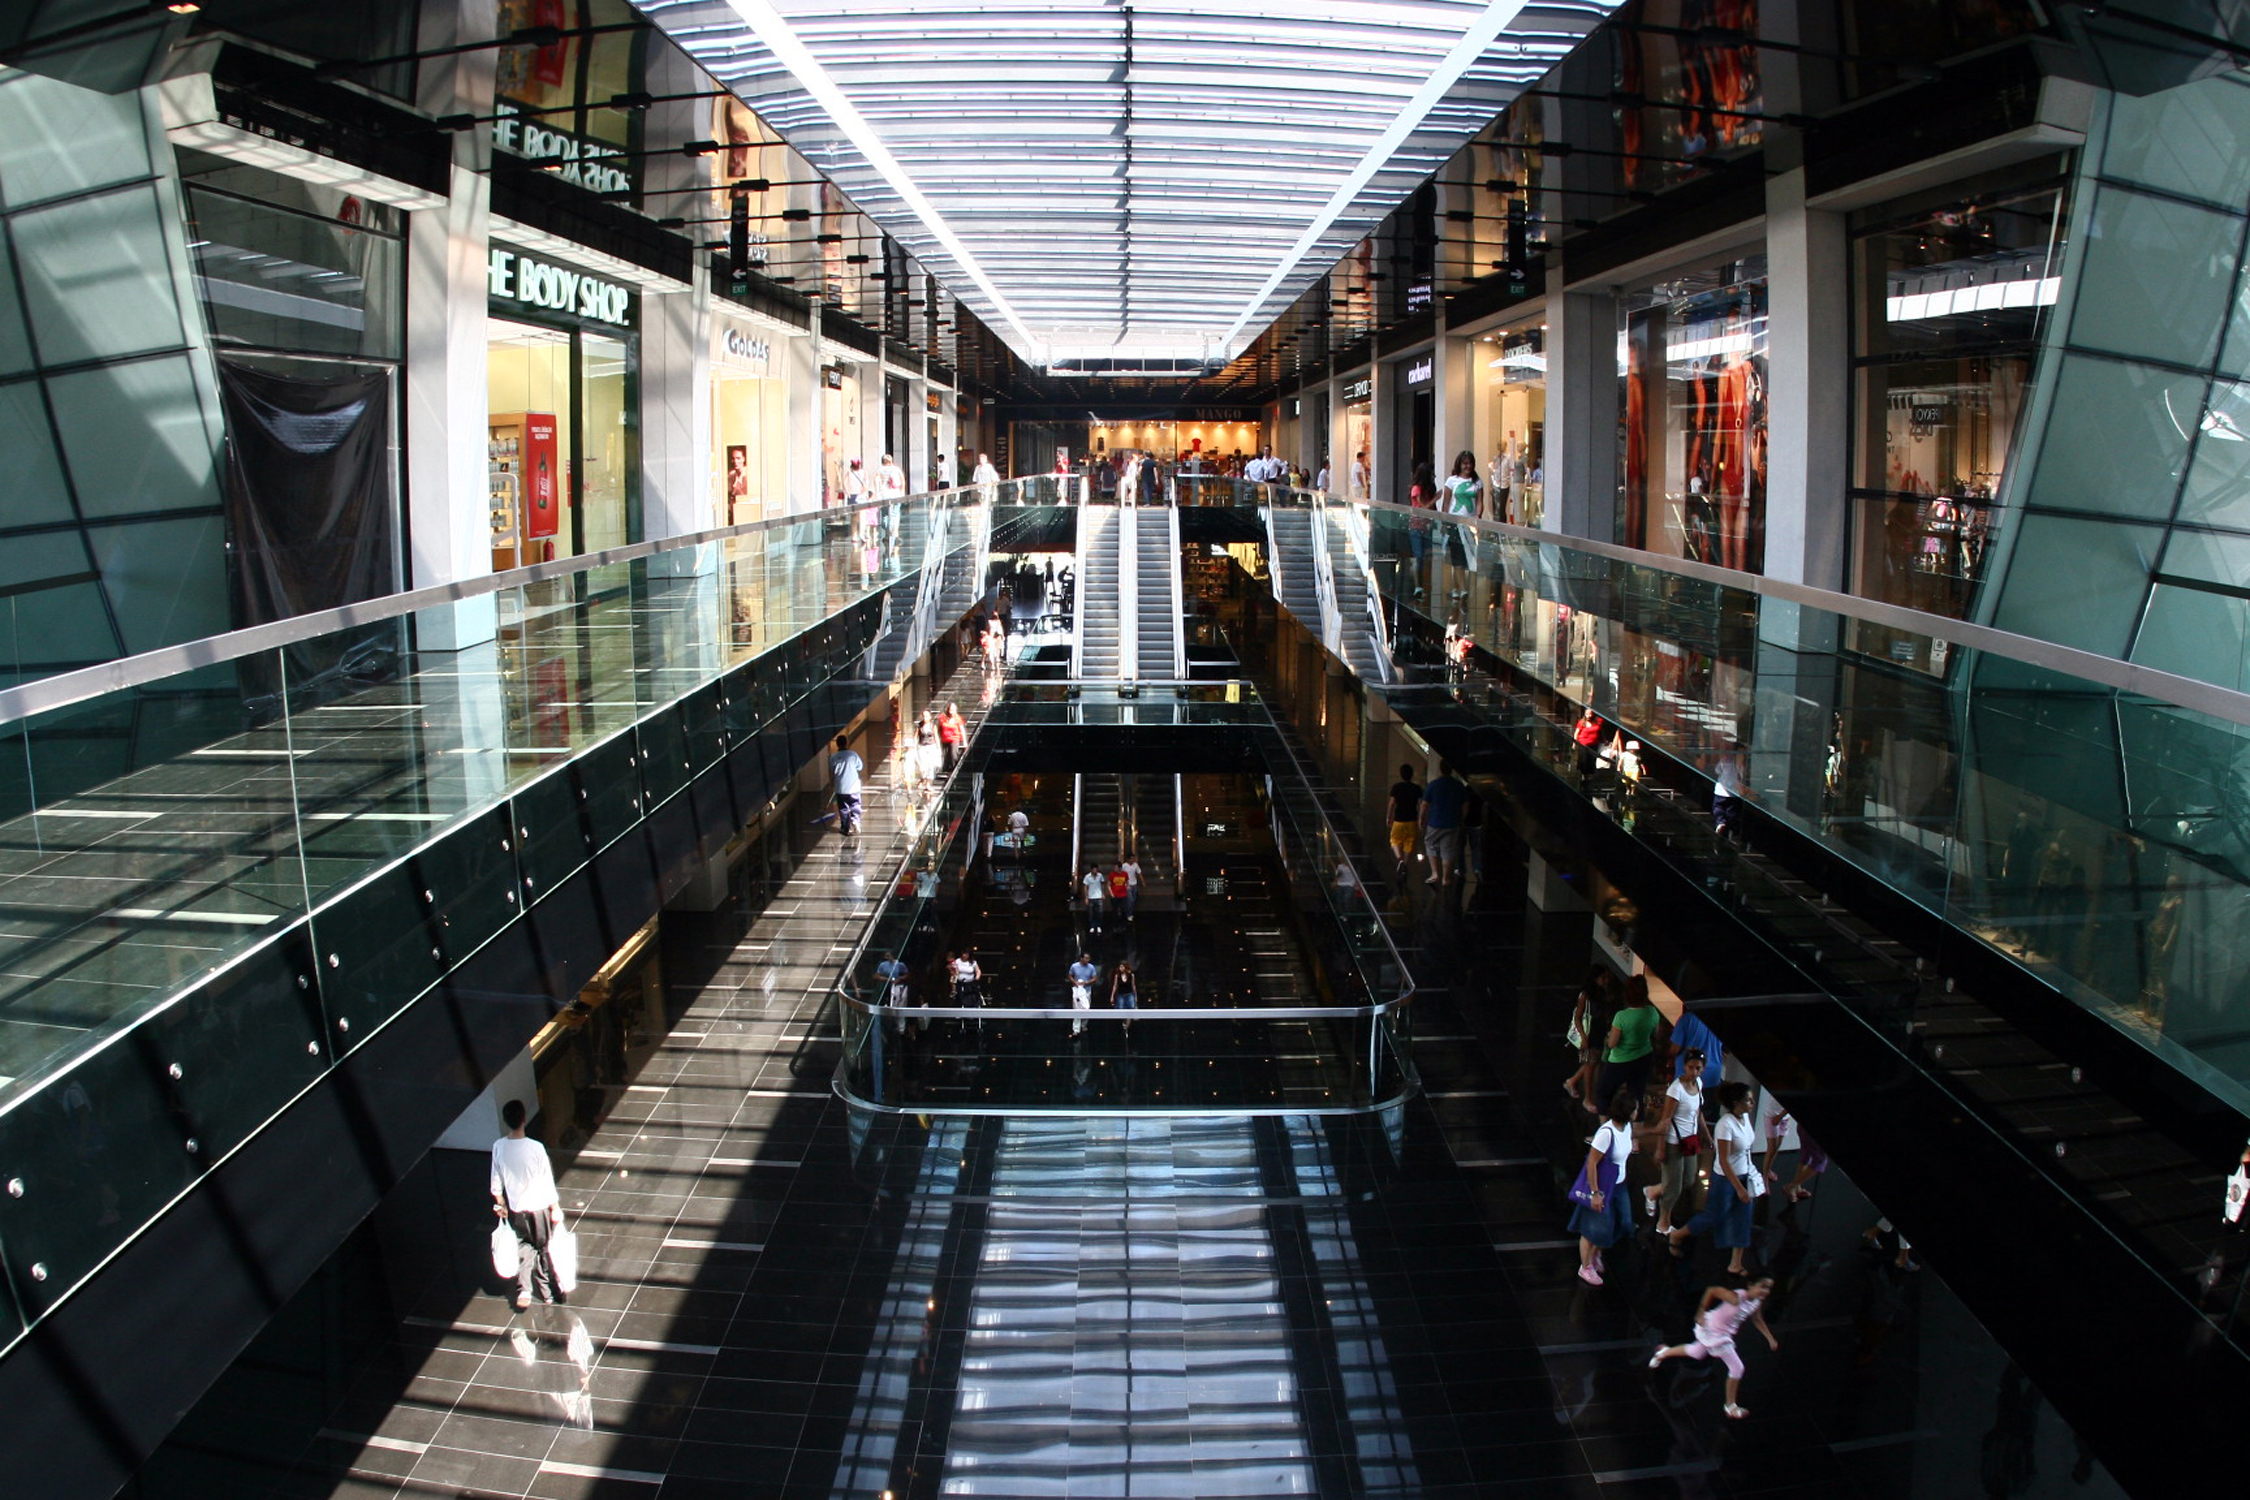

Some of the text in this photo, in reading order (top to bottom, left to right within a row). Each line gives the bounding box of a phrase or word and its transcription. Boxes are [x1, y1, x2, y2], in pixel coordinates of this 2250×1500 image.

[488, 249, 515, 298] HE
[518, 257, 580, 313] BODY
[732, 285, 747, 294] EXIT
[1510, 285, 1525, 294] EXIT
[1196, 408, 1242, 420] MANGO
